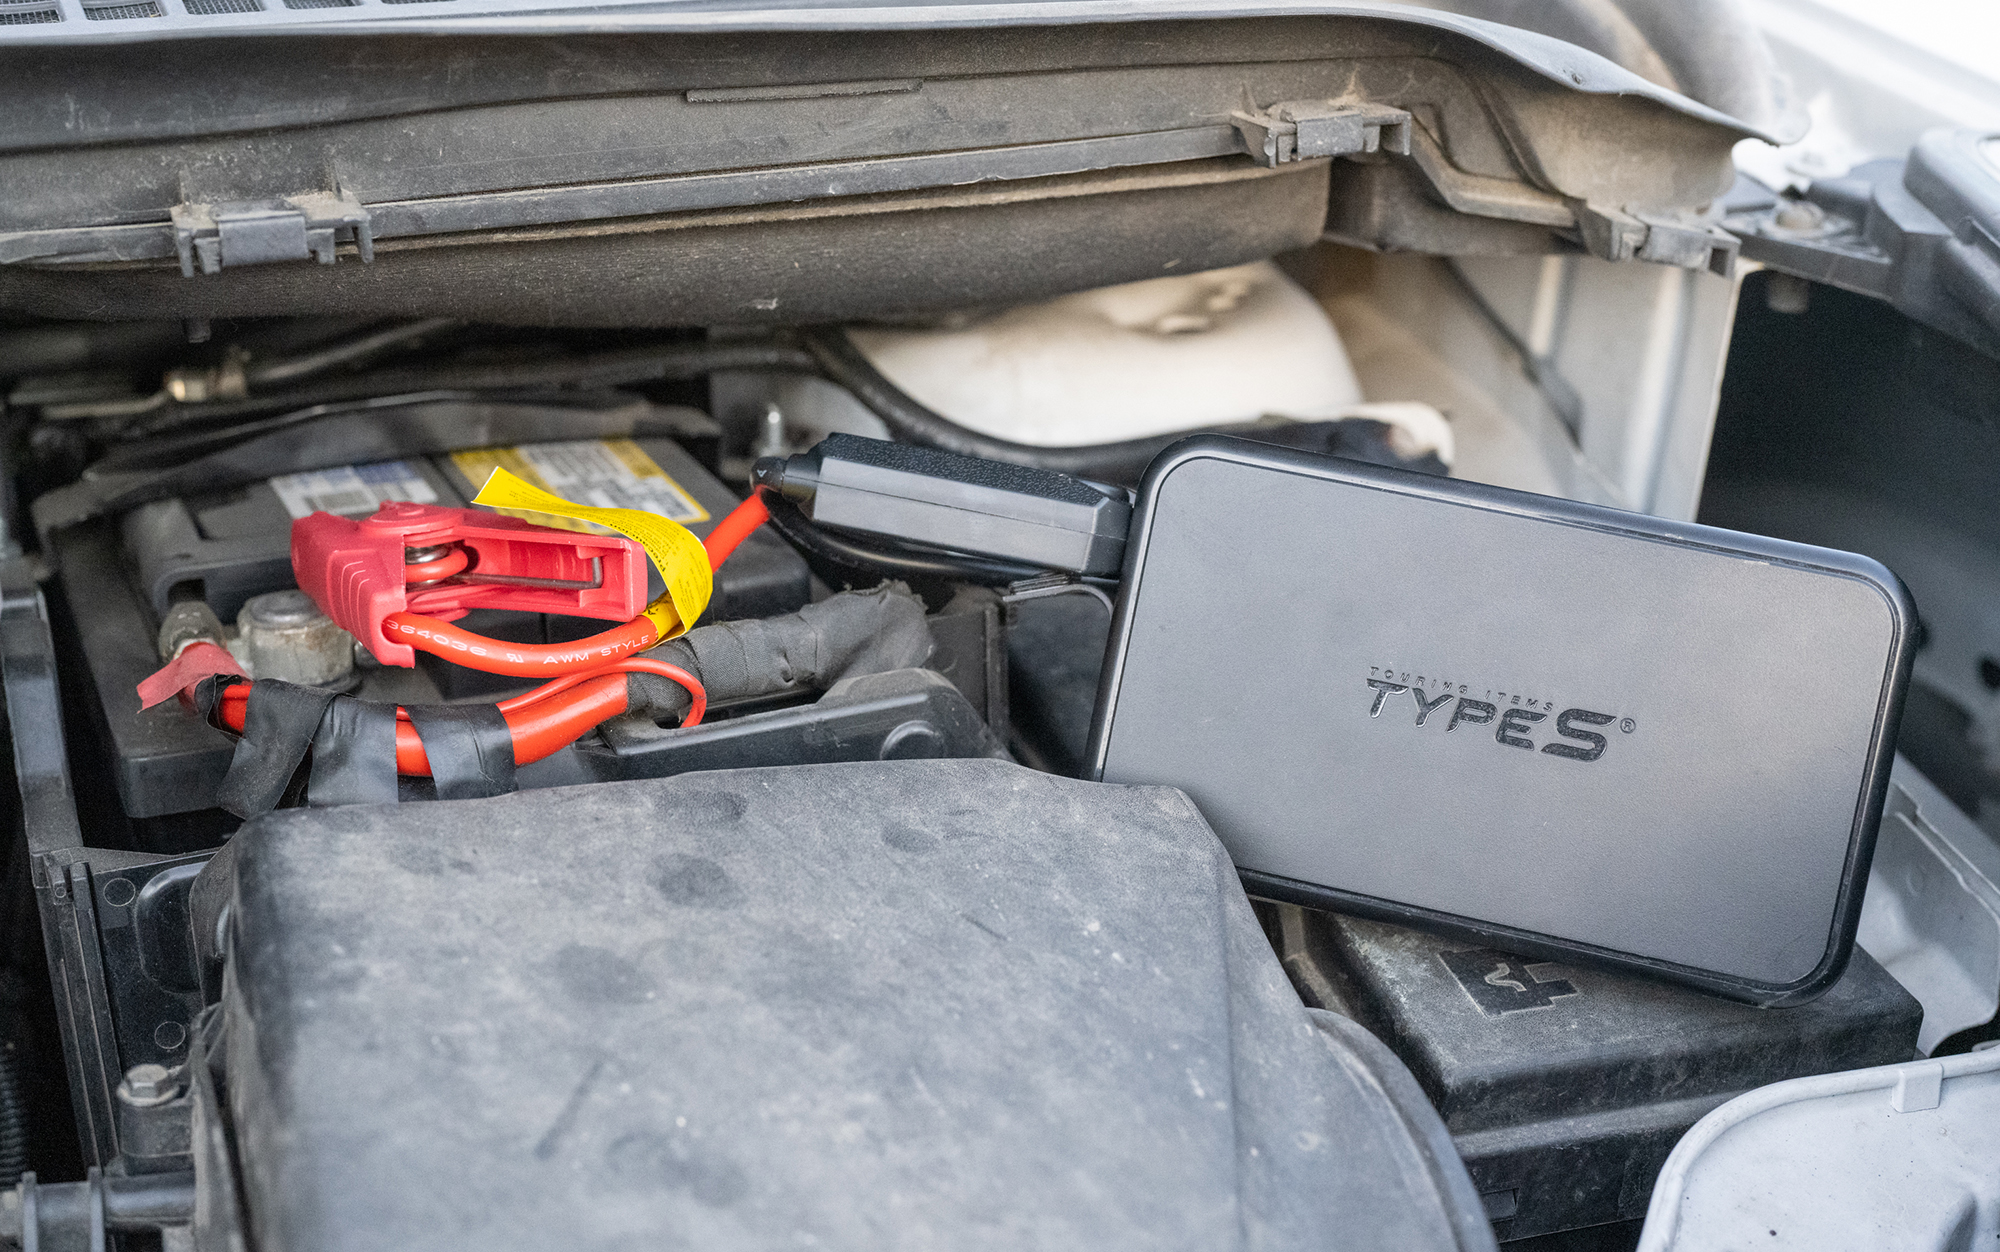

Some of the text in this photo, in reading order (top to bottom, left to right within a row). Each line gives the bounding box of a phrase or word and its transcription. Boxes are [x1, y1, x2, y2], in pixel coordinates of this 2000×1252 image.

[543, 652, 589, 665] AWM
[600, 634, 649, 657] STYLE
[1370, 666, 1553, 712] TOURING ITEMS
